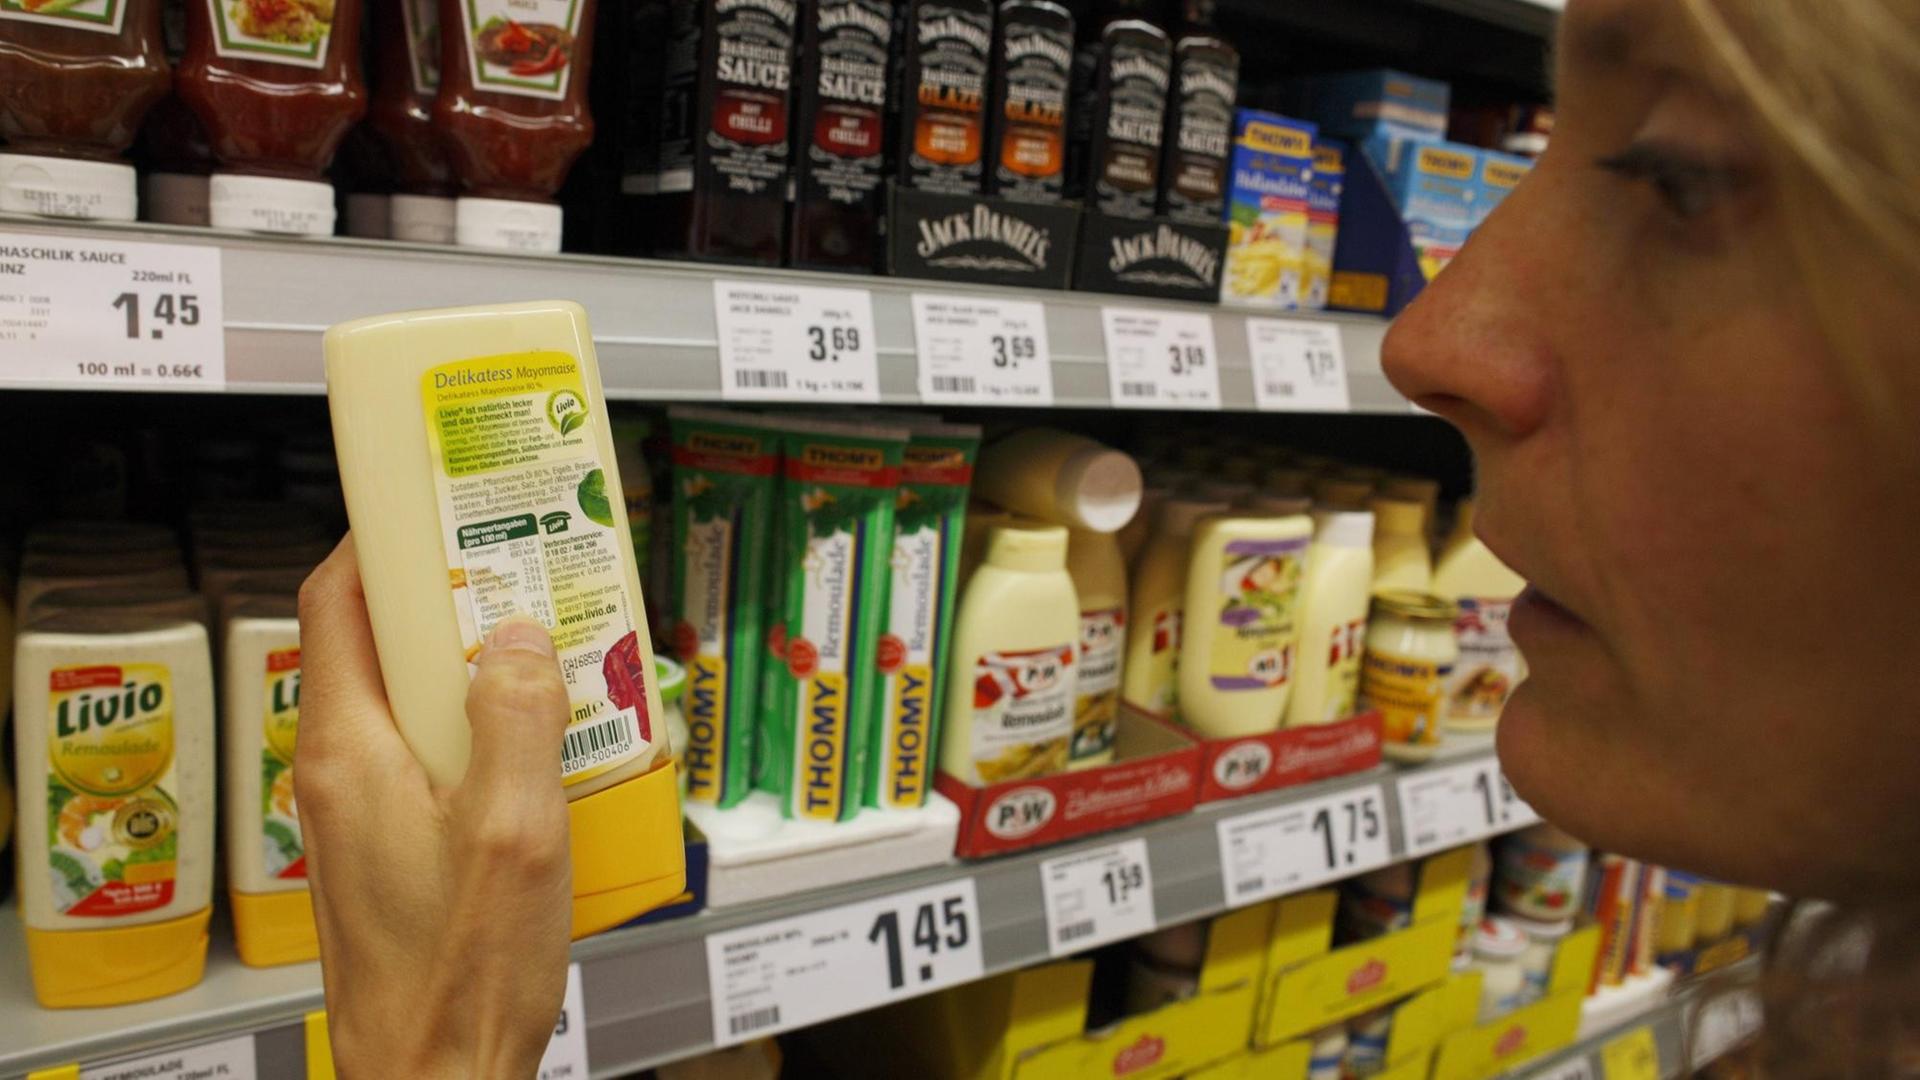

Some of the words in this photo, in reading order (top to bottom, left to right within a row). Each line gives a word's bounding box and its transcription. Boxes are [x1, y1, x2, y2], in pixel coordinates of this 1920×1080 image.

[717, 54, 791, 91] SAUCE
[818, 71, 886, 105] SAUCE
[80, 251, 126, 264] SAUCE
[132, 270, 173, 283] 220ml
[178, 273, 191, 284] FL
[112, 293, 199, 339] 1.45
[808, 326, 860, 362] 3.69
[991, 335, 1035, 368] 3.69
[77, 363, 108, 376] 100
[114, 363, 135, 376] ml
[158, 364, 203, 377] 0.66€
[435, 368, 513, 388] Delikatess
[516, 363, 576, 380] Mayonnaise
[437, 391, 479, 402] Delikatess
[481, 385, 525, 397] Mayonnaise
[466, 404, 477, 414] ist
[478, 400, 511, 413] natürlich
[512, 399, 533, 409] lecker
[556, 398, 575, 414] Livio
[442, 417, 458, 428] und
[459, 416, 474, 424] das
[476, 411, 512, 423] schmeckt
[810, 448, 878, 467] THOMY
[462, 518, 528, 538] Nährwertangaben
[464, 536, 480, 548] (pro
[481, 533, 495, 545] 100
[559, 603, 617, 626] www.livio.de
[566, 672, 576, 685] 51
[57, 681, 163, 738] Livio
[575, 704, 591, 721] ml
[690, 661, 718, 791] THOMY
[894, 672, 924, 801] THOMY
[591, 742, 630, 764] 500406
[807, 678, 837, 812] THOMY
[1311, 796, 1380, 870] 1.75
[869, 896, 970, 989] 1.45
